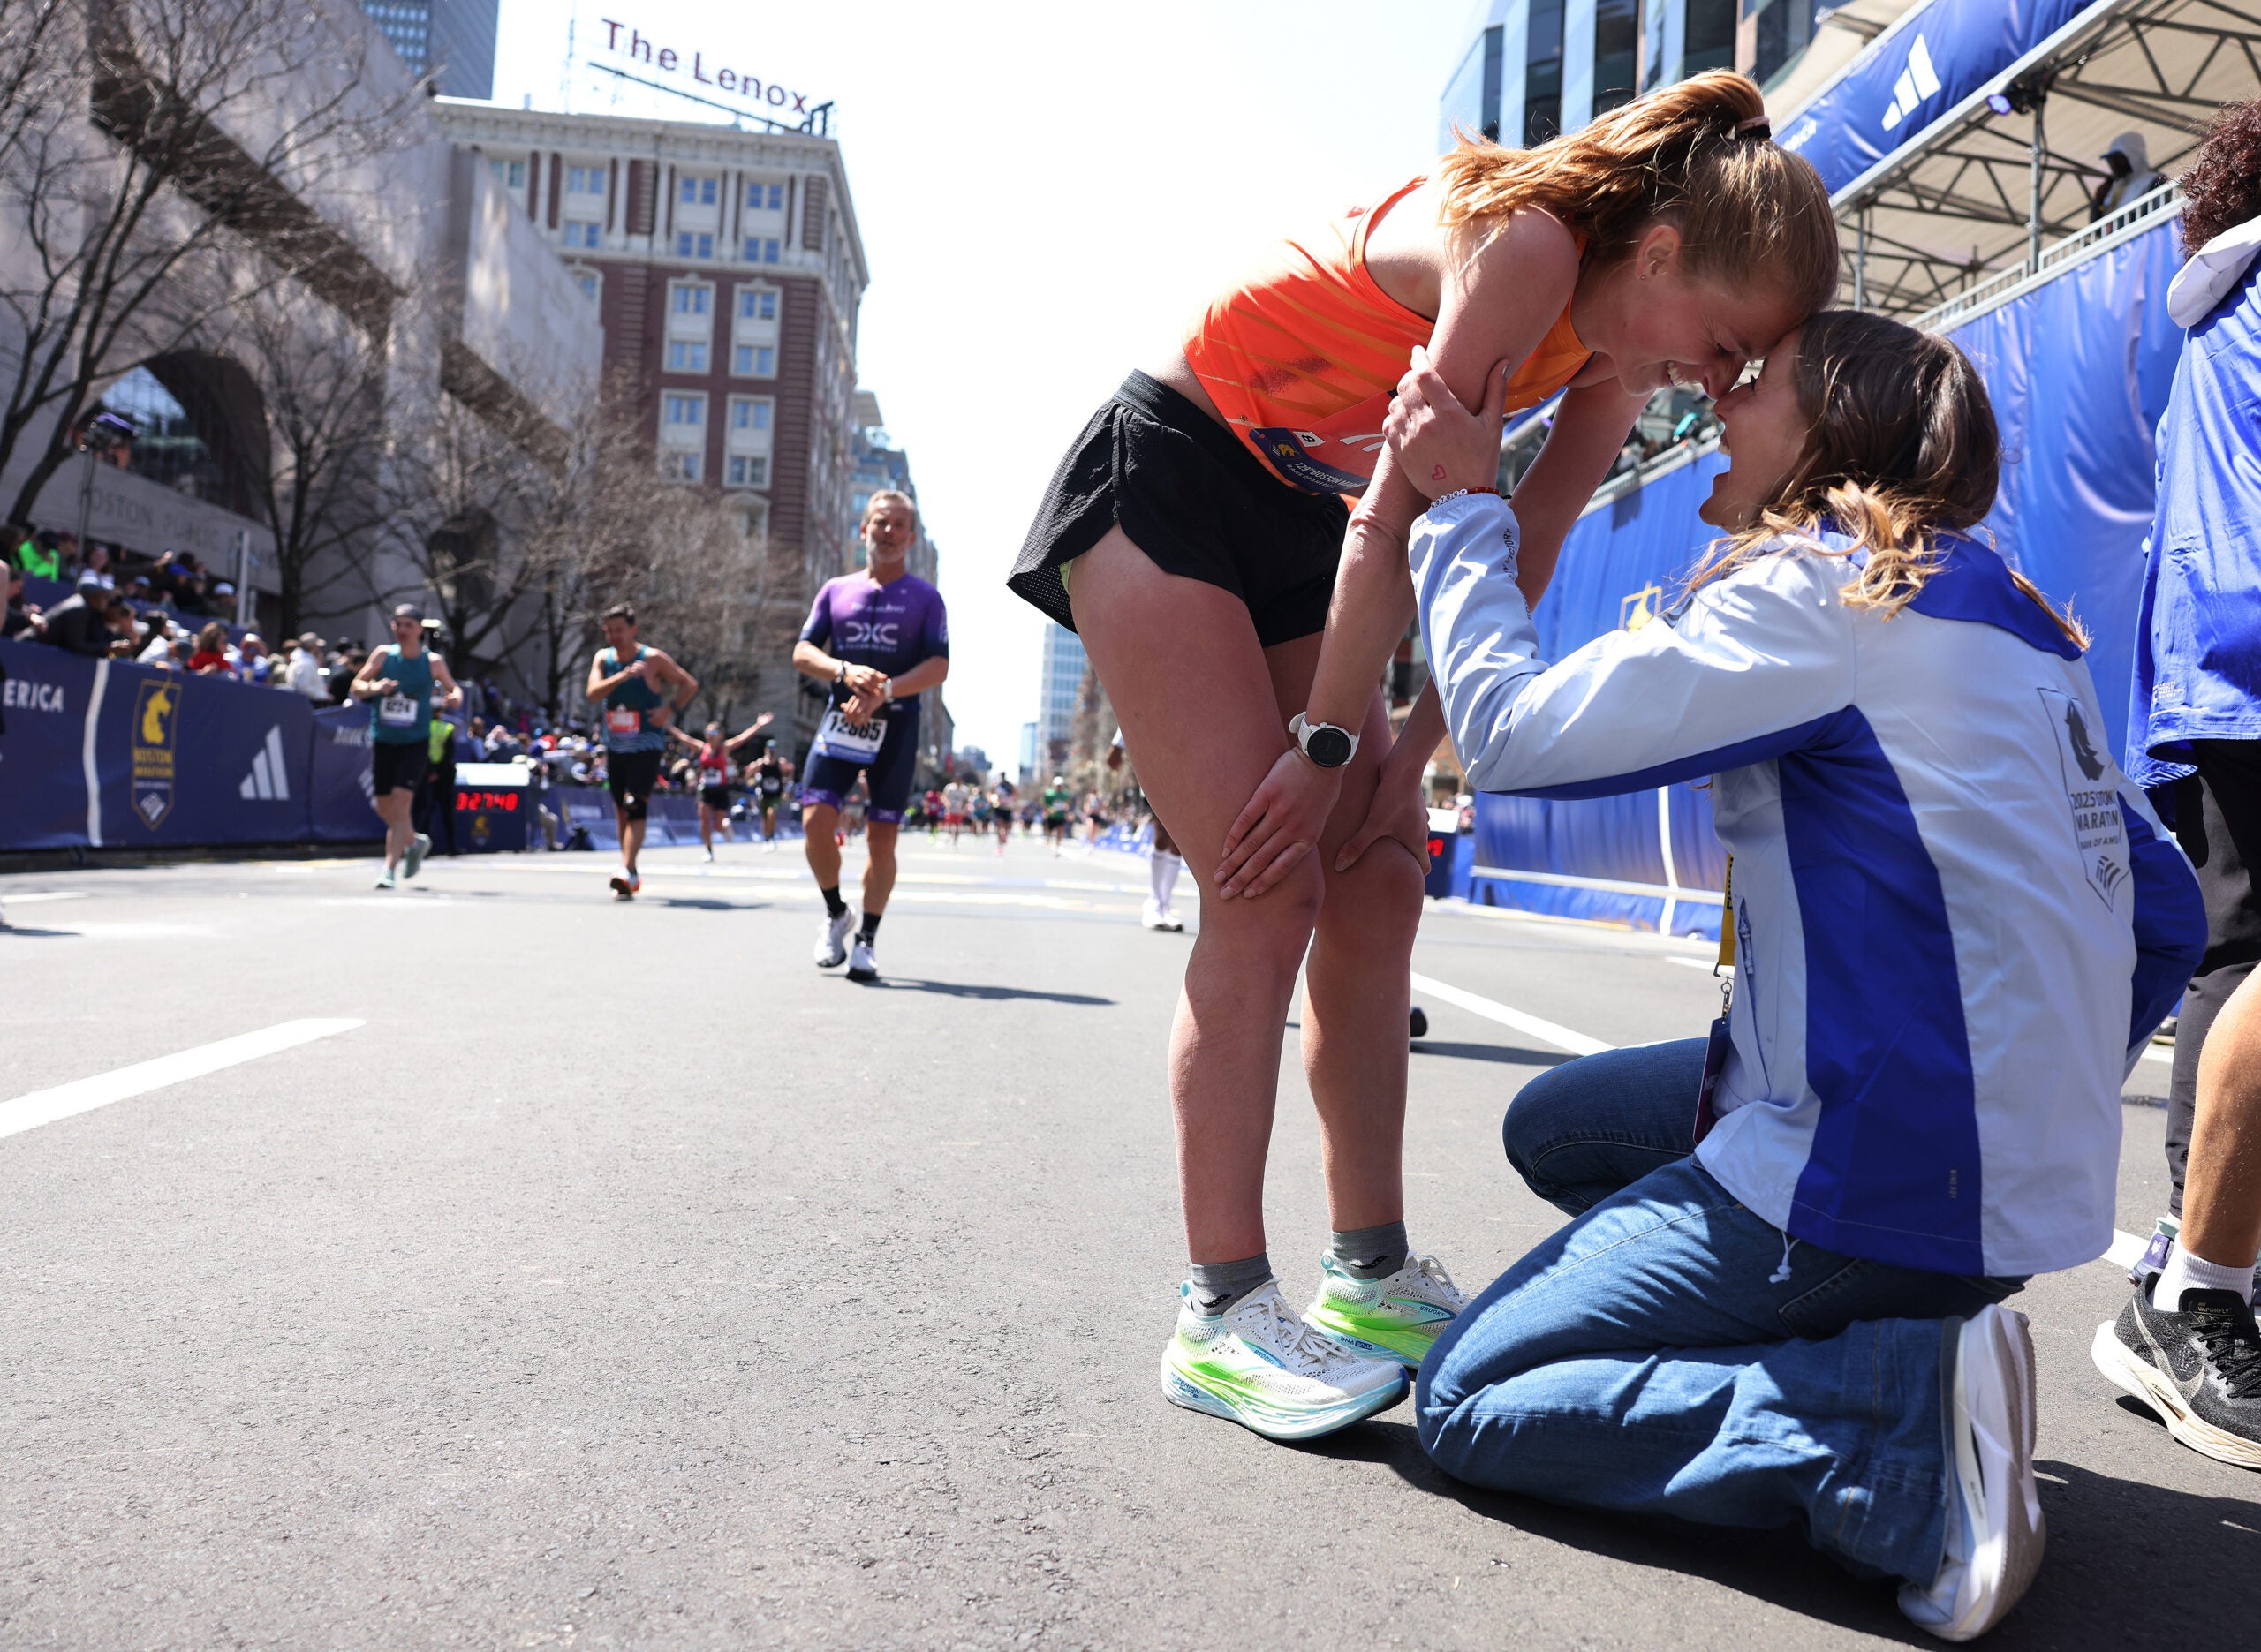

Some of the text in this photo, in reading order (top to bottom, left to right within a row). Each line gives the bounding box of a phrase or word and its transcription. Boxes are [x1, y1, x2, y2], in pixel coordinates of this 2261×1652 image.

[601, 18, 807, 114] The Lenox
[1311, 470, 1341, 484] BOSTON
[845, 621, 899, 645] DXC
[2070, 791, 2096, 810] 2025
[1419, 1305, 1445, 1317] BROOKS
[1341, 1335, 1372, 1350] DNA GOLD
[1253, 1349, 1276, 1365] BROOKS
[1171, 1371, 1200, 1394] HYPERION
